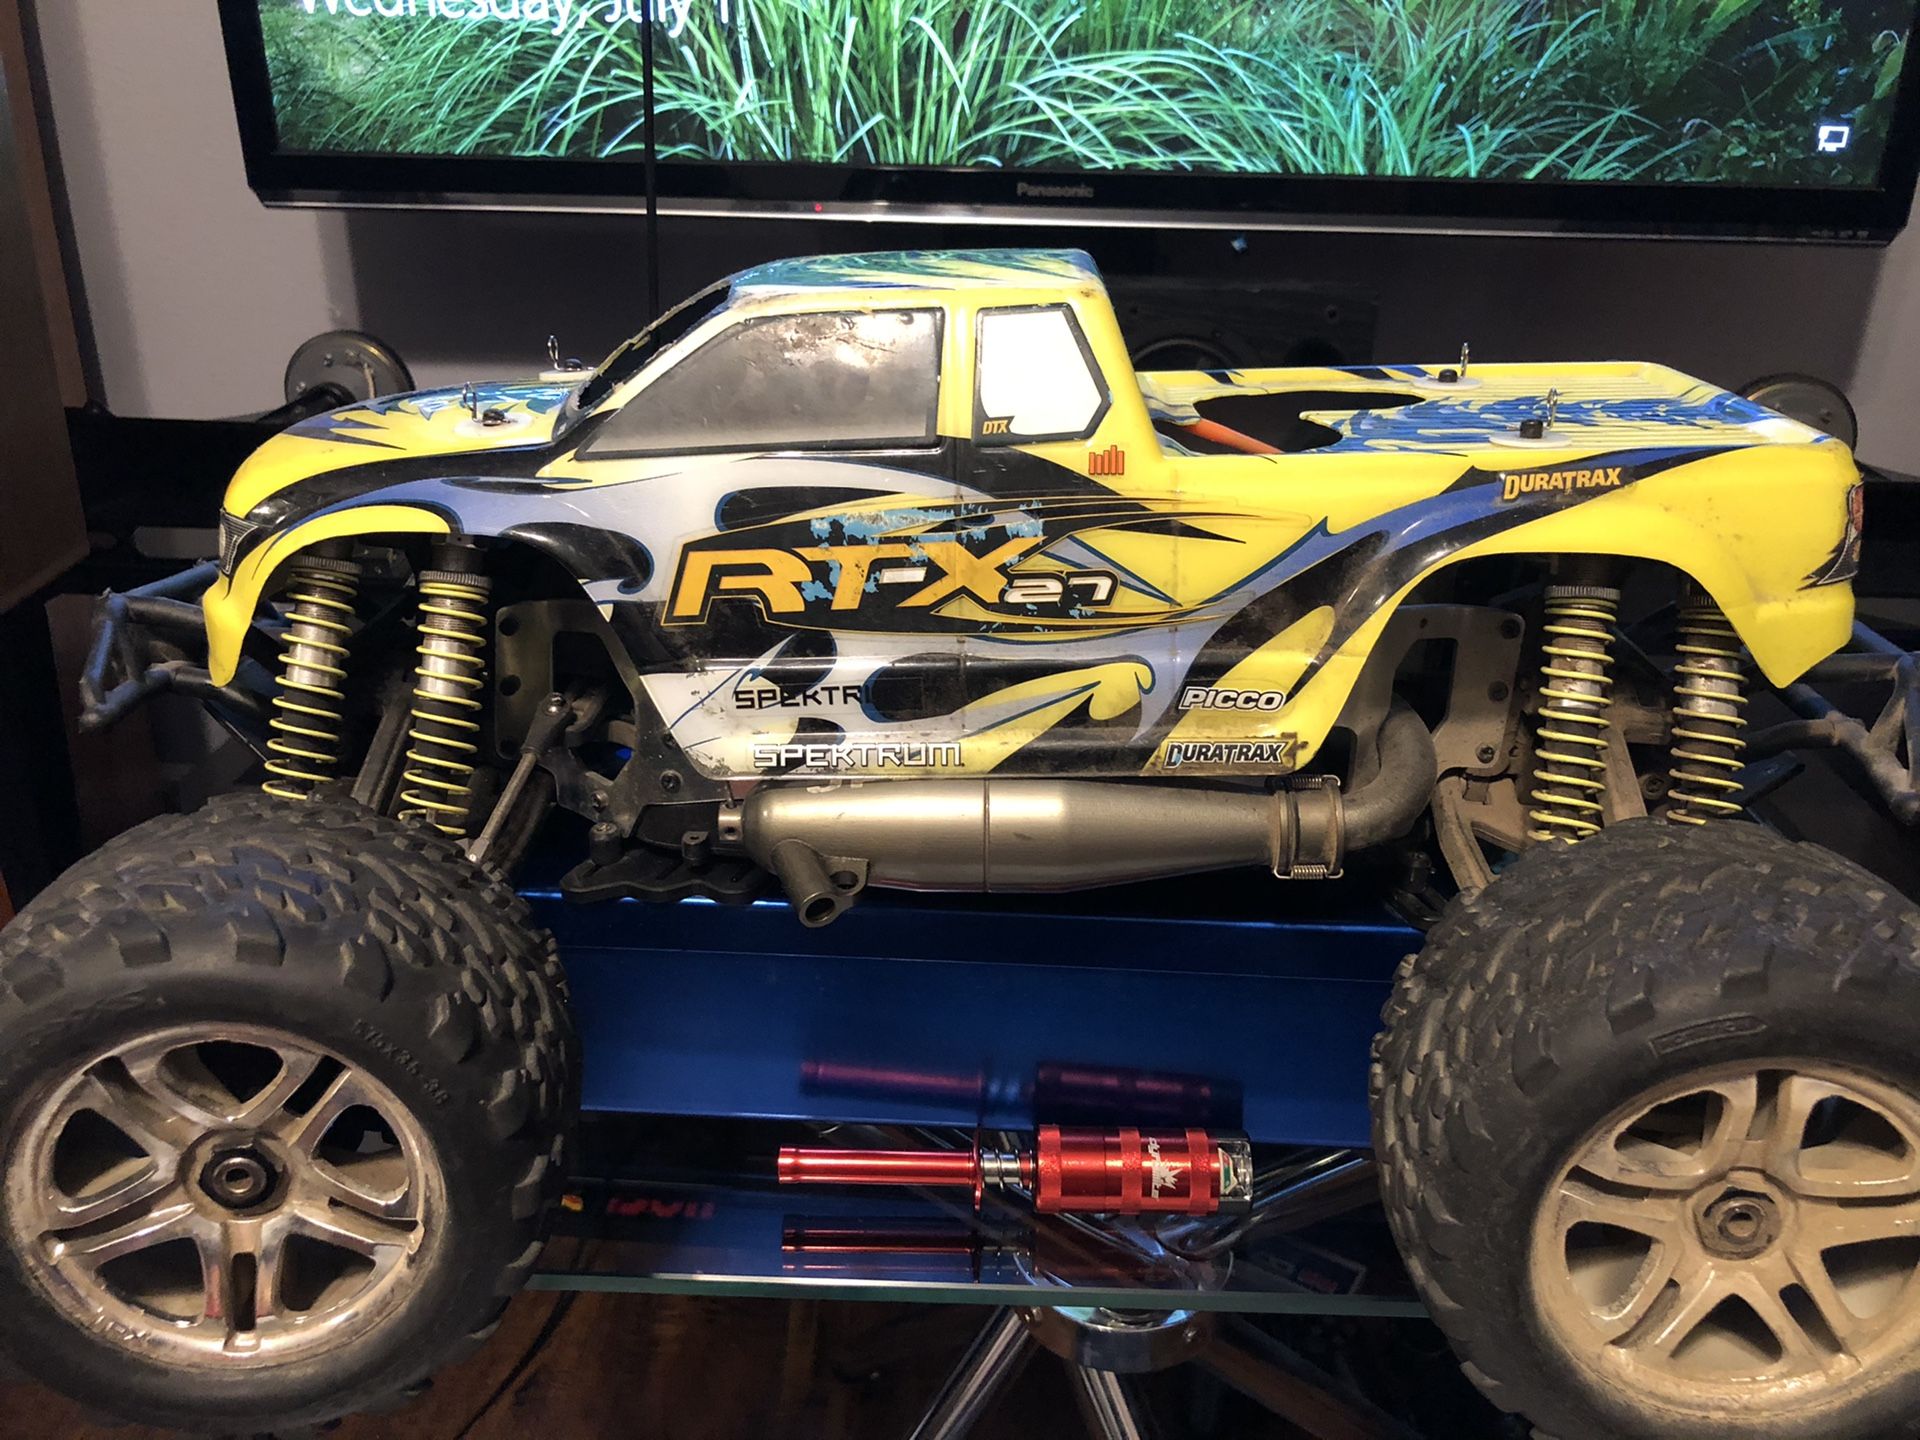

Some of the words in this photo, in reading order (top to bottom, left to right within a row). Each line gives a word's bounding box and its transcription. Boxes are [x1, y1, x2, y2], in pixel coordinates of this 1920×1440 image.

[1016, 182, 1094, 199] Panasonic
[982, 419, 1009, 435] DTX
[1503, 467, 1622, 500] DURATRAX
[1003, 576, 1113, 604] 27
[1180, 687, 1286, 711] PICCO
[1165, 742, 1285, 768] DURATRAX
